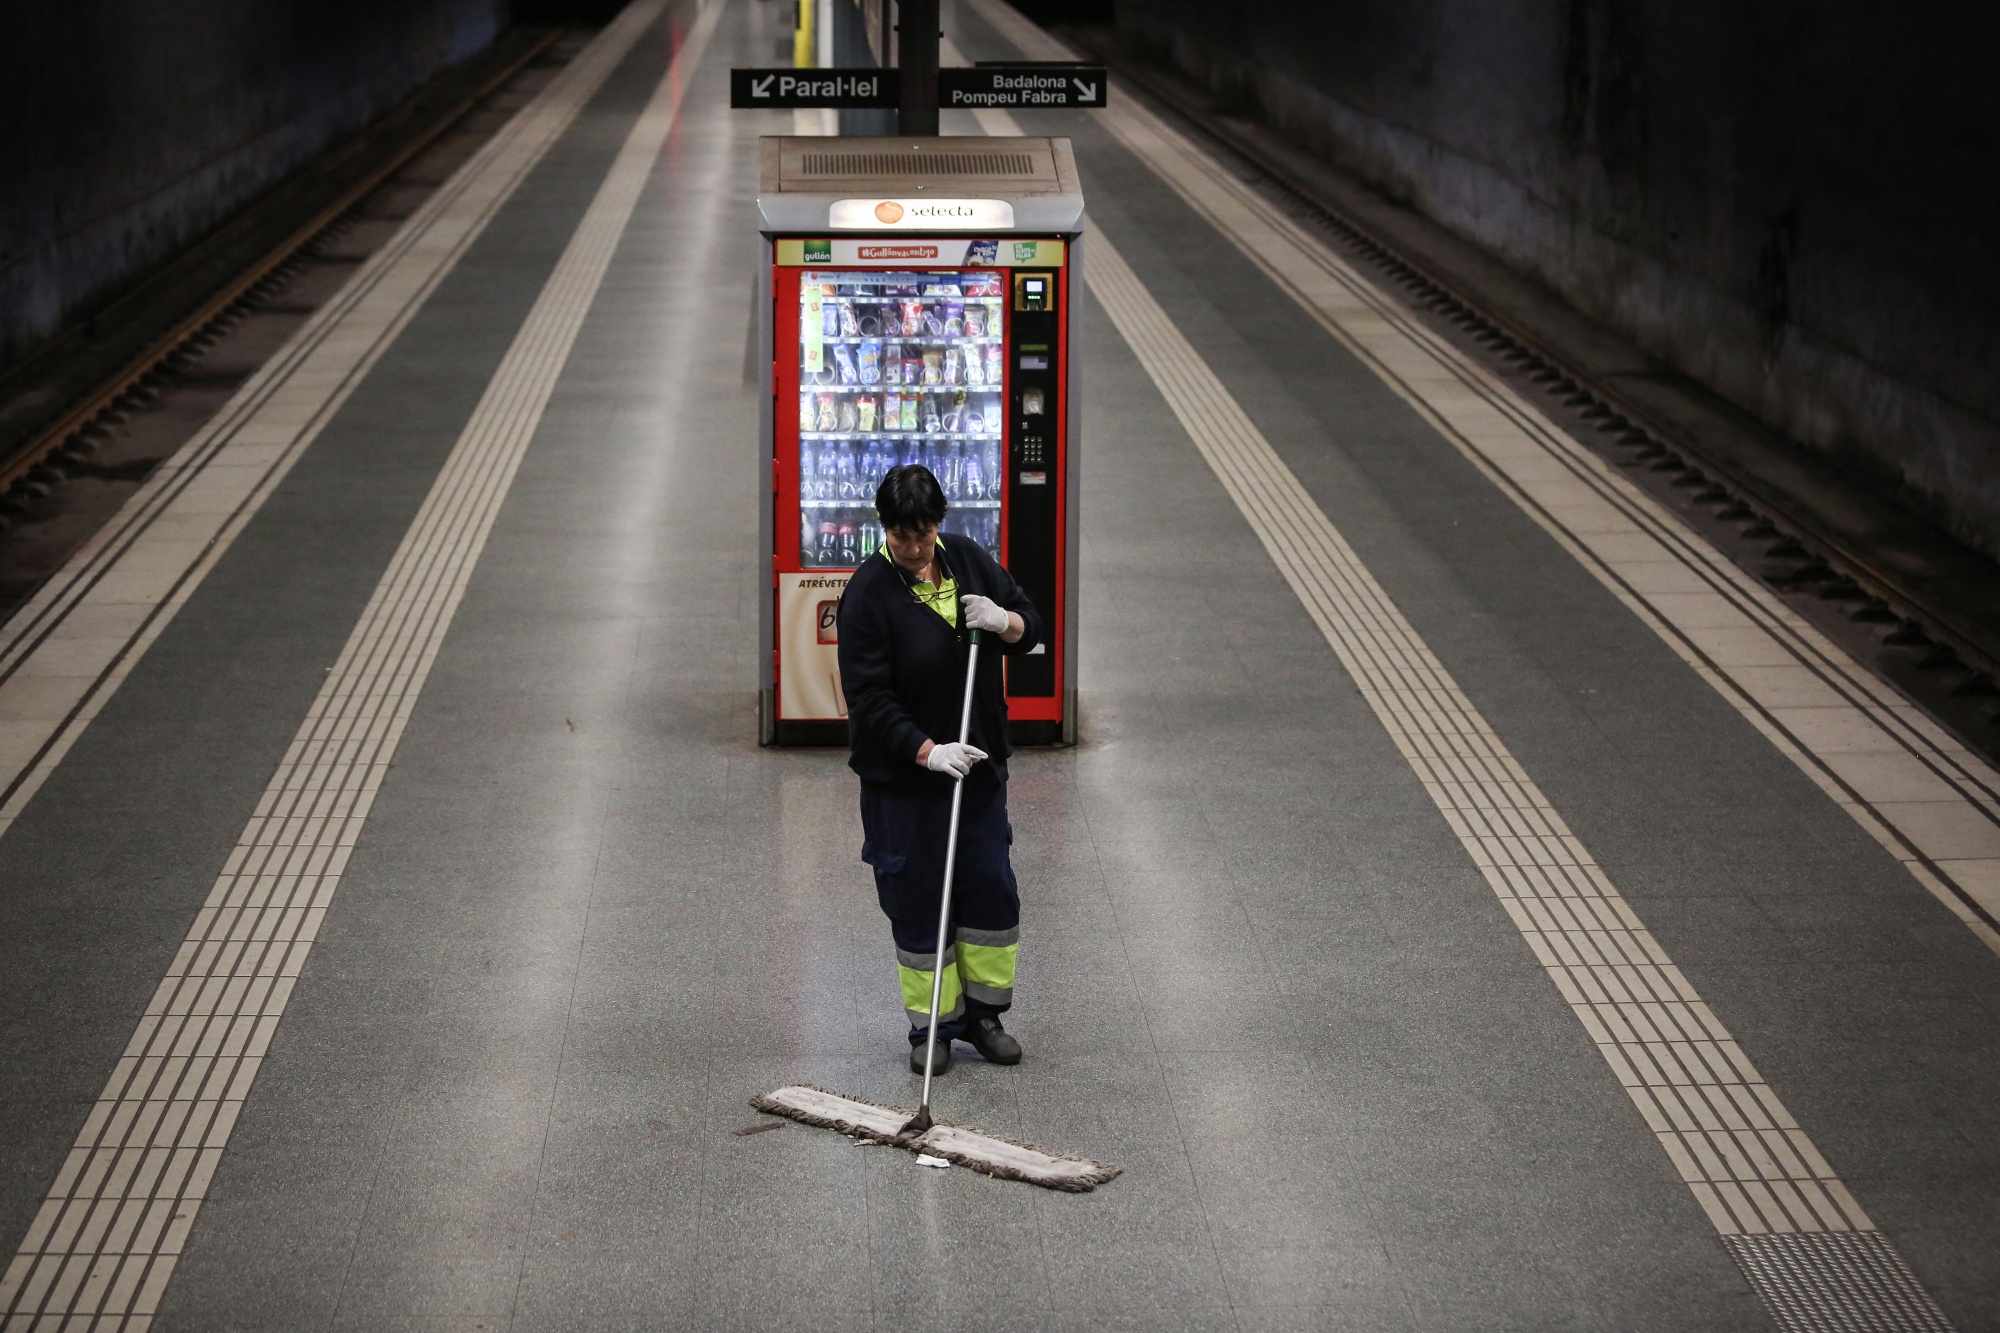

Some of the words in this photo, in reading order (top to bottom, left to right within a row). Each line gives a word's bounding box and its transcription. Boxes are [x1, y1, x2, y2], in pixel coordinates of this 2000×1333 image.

[779, 76, 877, 97] Paral·lel
[993, 75, 1067, 89] Badalona
[952, 91, 1017, 107] Pompeu
[1021, 91, 1067, 103] Fabra
[911, 206, 973, 216] selecta
[804, 251, 830, 262] gullón
[798, 576, 849, 588] ATRÉVETE
